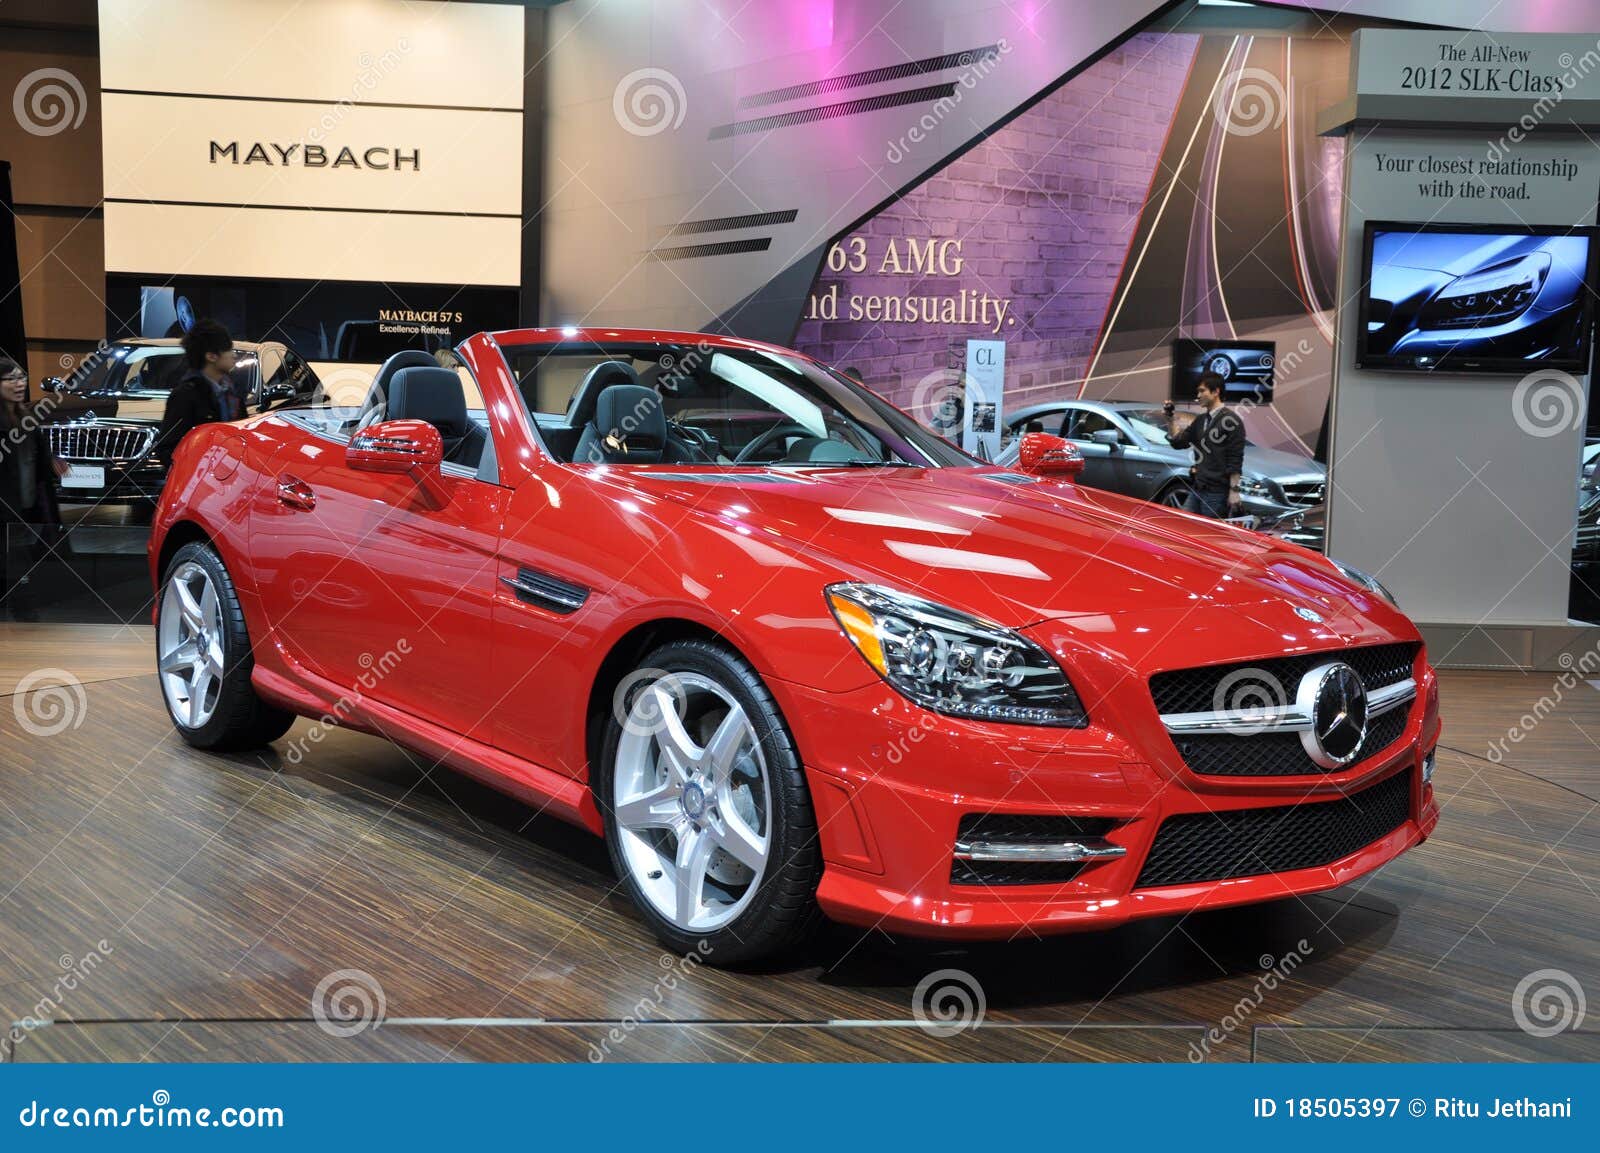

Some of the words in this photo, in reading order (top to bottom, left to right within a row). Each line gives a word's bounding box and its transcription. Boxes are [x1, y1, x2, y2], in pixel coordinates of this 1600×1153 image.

[1439, 44, 1466, 61] The
[1470, 46, 1531, 63] All-New
[1401, 66, 1452, 89] 2012
[1459, 67, 1564, 93] SLK-Class
[210, 140, 421, 171] MAYBACH
[1376, 153, 1414, 172] Your
[1419, 155, 1474, 174] closest
[1479, 157, 1578, 181] relationship
[1419, 179, 1453, 198] with
[1460, 181, 1485, 199] the
[1490, 182, 1531, 200] road.
[827, 237, 867, 273] 63
[878, 238, 965, 276] AMG
[379, 310, 437, 322] MAYBACH
[440, 312, 453, 321] 57
[455, 312, 463, 323] S
[850, 289, 1015, 334] sensuality.
[380, 324, 419, 334] Excellence
[421, 325, 451, 335] Refined.
[976, 348, 997, 366] CL
